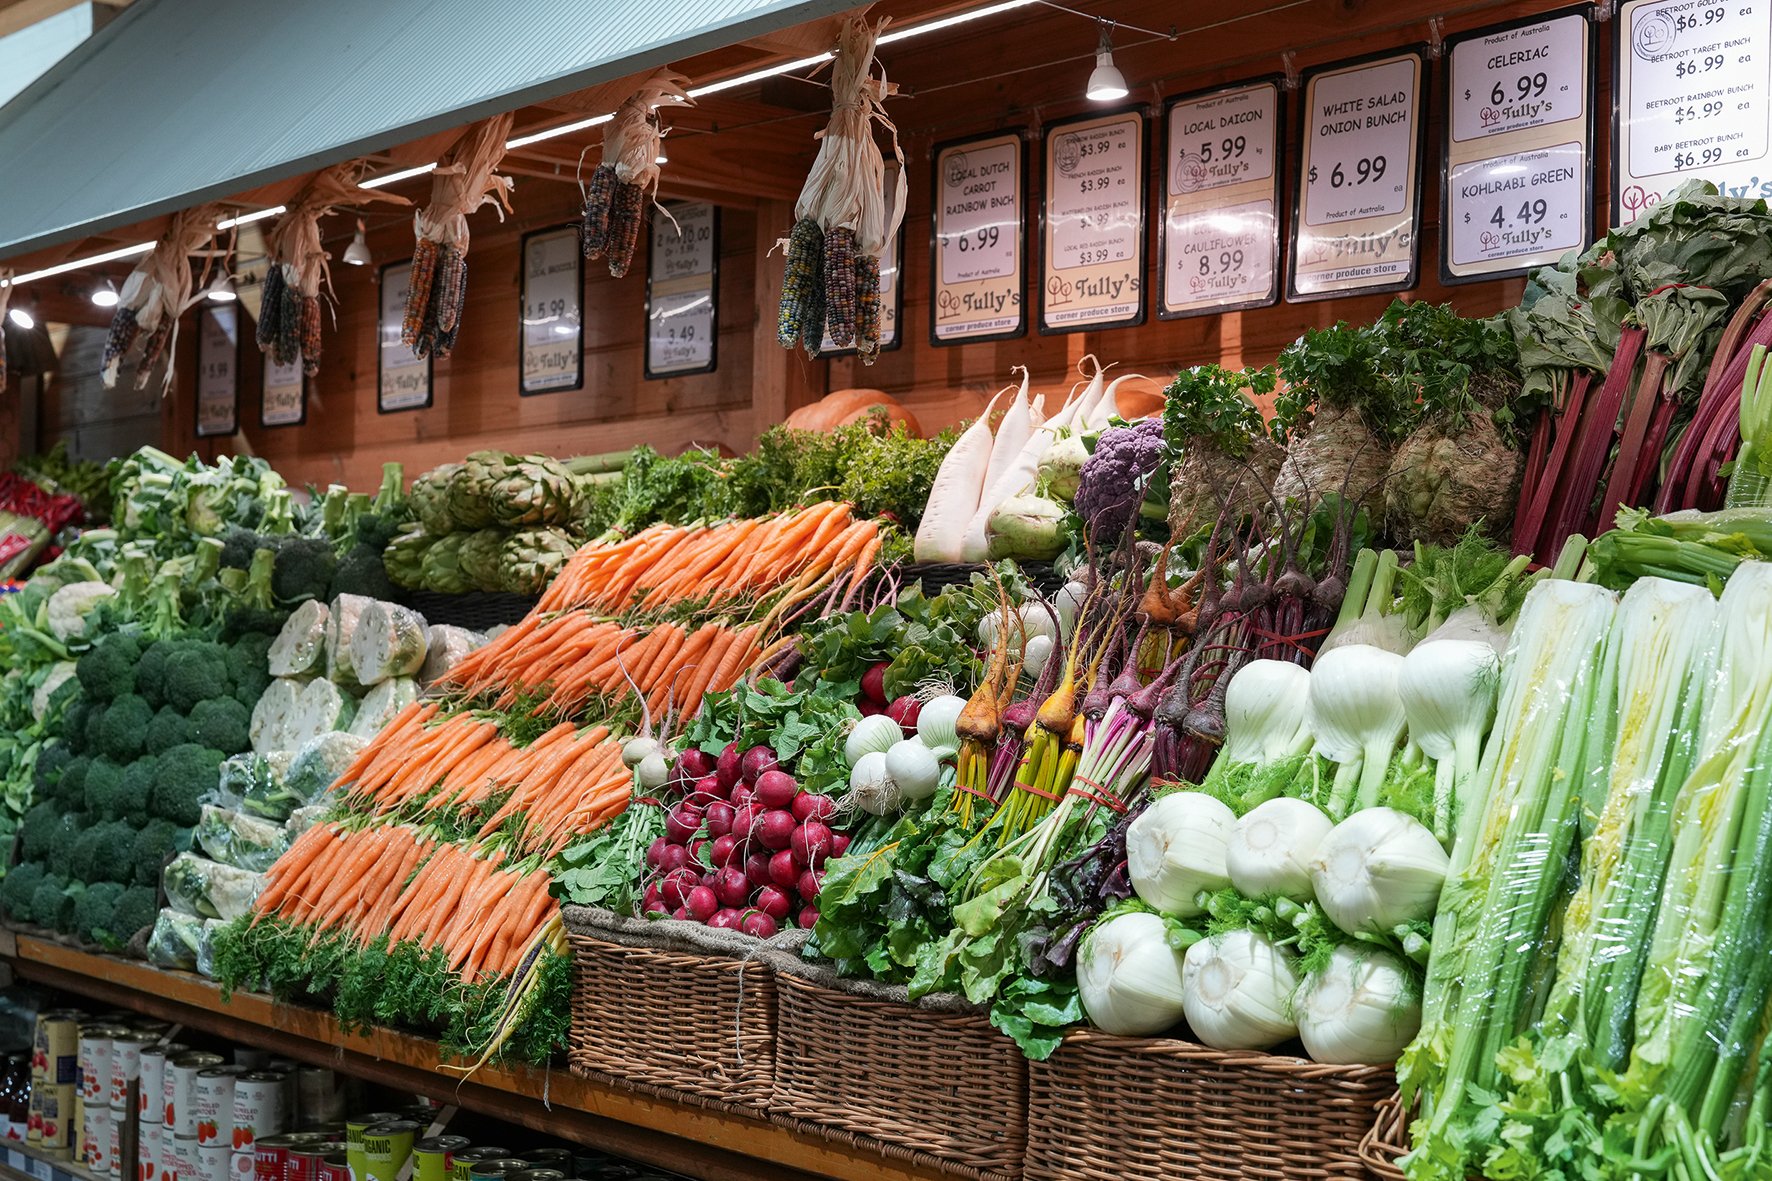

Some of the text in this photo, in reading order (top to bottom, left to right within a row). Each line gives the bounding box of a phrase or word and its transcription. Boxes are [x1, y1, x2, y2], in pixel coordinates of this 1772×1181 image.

[1656, 2, 1694, 16] BEETROOT
[1676, 6, 1752, 33] $6.99 ea
[1484, 25, 1550, 46] Product of Australia
[1487, 45, 1549, 70] CELERIAC
[1650, 36, 1751, 64] BEETROOT TARGET BUNCH
[1676, 54, 1751, 80] $6.99 ea
[1464, 72, 1568, 106] $ 6.99 ea
[1646, 83, 1754, 110] BEETROOT RAINBOW BUNCH
[1196, 94, 1249, 110] Product of Australia
[1323, 91, 1406, 117] WHITE SALAD
[1502, 100, 1552, 120] Tully's
[1184, 109, 1263, 136] LOCAL DAICON
[1320, 110, 1406, 136] ONION BUNCH
[1675, 101, 1750, 125] $6.99 ea
[1090, 132, 1108, 140] RADISH
[1109, 128, 1126, 136] BUNCH
[1488, 118, 1544, 134] corner produce store
[1080, 140, 1110, 158] $3.99
[1180, 148, 1186, 160] $
[1200, 136, 1246, 164] 5.99
[1654, 132, 1744, 153] BABY BEETROOT BUNCH
[1209, 160, 1249, 177] Tully's
[1509, 157, 1516, 165] of
[1519, 152, 1549, 162] Australia
[1674, 148, 1749, 172] $6.99 ea
[951, 162, 1010, 182] LOCAL DUTCH
[1087, 168, 1105, 176] RADISH
[1106, 165, 1122, 173] BUNCH
[1308, 156, 1403, 192] $ 6.99 ea
[963, 181, 997, 196] CARROT
[1080, 176, 1126, 194] $3.99 ea
[1462, 167, 1574, 199] KOHLRABI GREEN
[946, 195, 1014, 216] RAINBOW BNCH
[1326, 205, 1385, 220] Product of Australia
[1464, 198, 1568, 229] $ 4.49 ea
[657, 234, 663, 248] 2
[958, 226, 1000, 252] 6.99
[1184, 233, 1257, 254] CAULIFLOWER
[1502, 226, 1552, 244] Tully's
[1080, 249, 1108, 266] $3.99
[1506, 247, 1528, 256] produce
[1530, 244, 1544, 252] store
[1178, 260, 1183, 270] $
[1200, 250, 1244, 276] 8.99
[1336, 268, 1372, 280] produce
[1374, 263, 1396, 273] store
[1075, 274, 1140, 299] Tully's
[1207, 274, 1248, 288] Tully's
[538, 299, 565, 320] 599
[962, 288, 1020, 314] Tully's
[1056, 305, 1130, 320] corner produce store
[668, 325, 696, 345] 3.49
[945, 318, 1012, 333] corner produce store
[540, 350, 578, 370] Tully's
